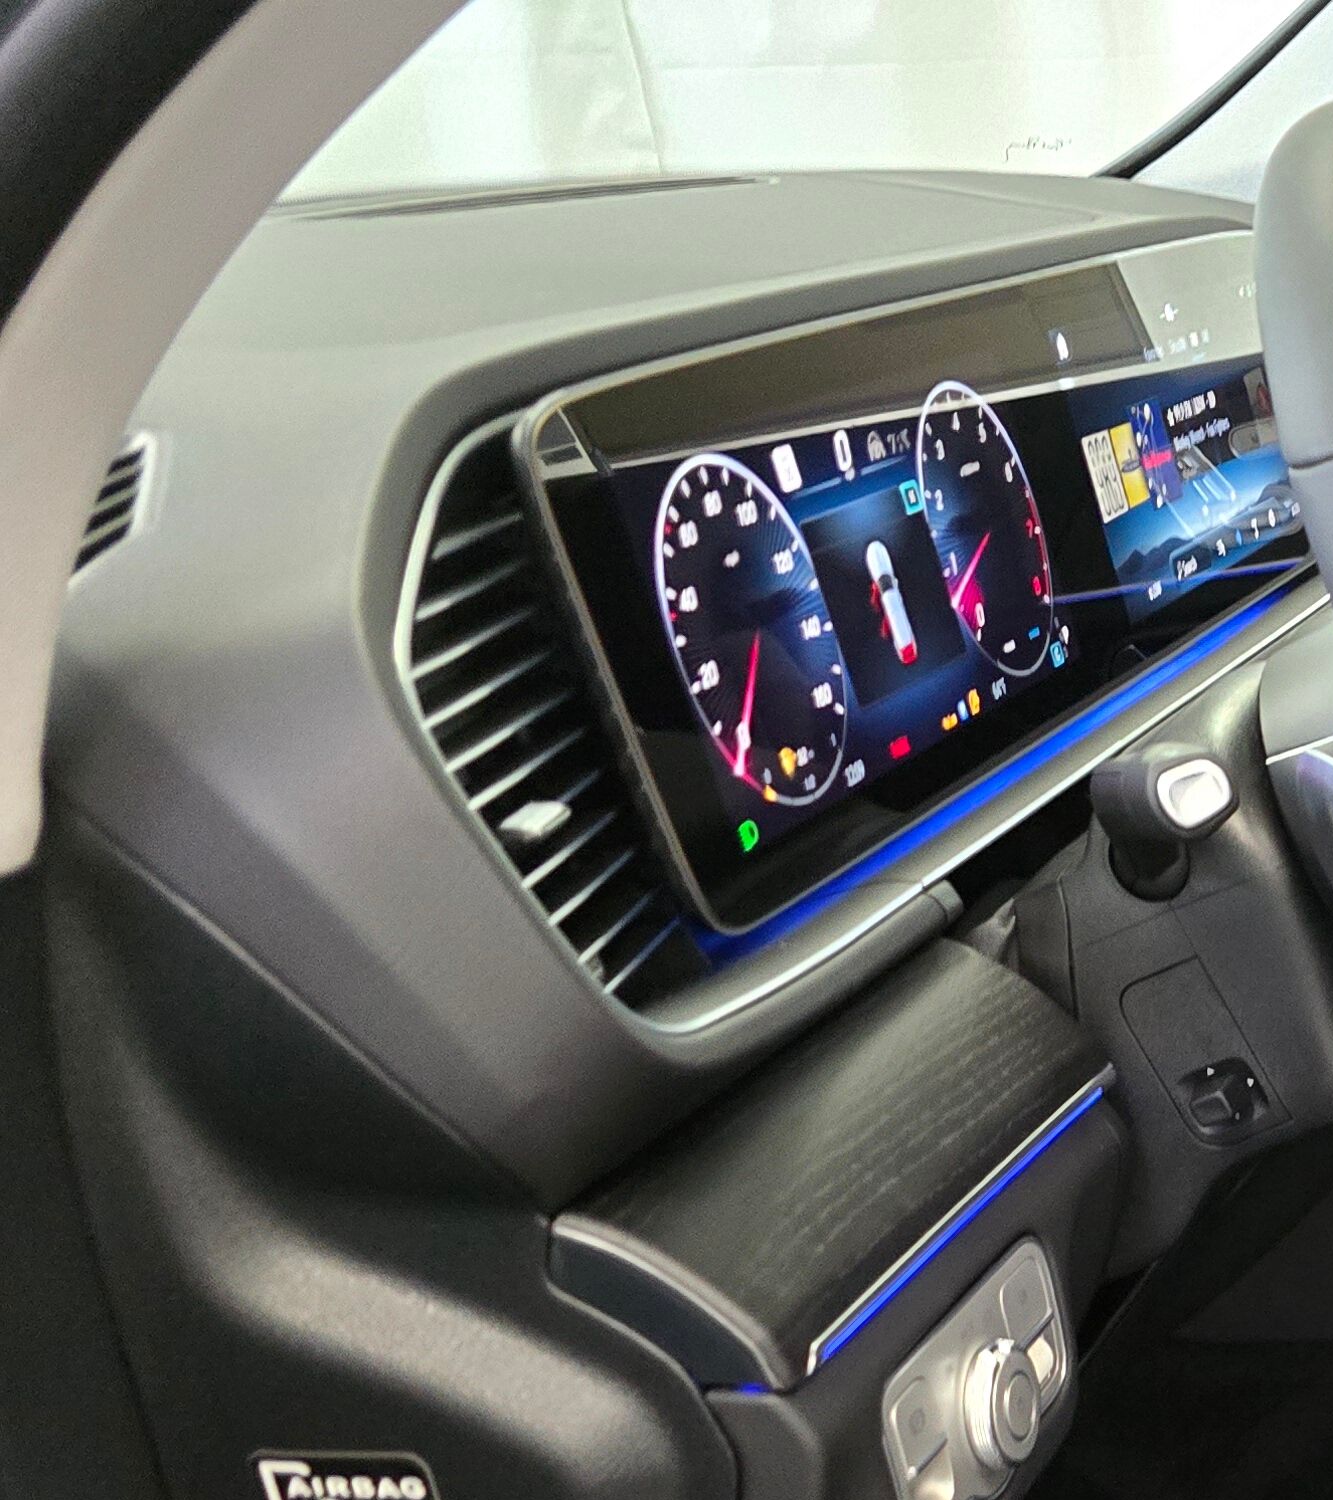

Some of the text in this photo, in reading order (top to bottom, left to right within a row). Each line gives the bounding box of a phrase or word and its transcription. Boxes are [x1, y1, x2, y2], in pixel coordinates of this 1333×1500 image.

[977, 422, 987, 443] 5
[833, 429, 852, 472] 0
[935, 439, 945, 461] 3
[703, 489, 723, 518] 80
[735, 499, 758, 527] 100
[935, 489, 944, 512] 2
[772, 548, 795, 575] 120
[678, 585, 699, 612] 40
[801, 614, 821, 640] 140
[699, 659, 720, 690] 20
